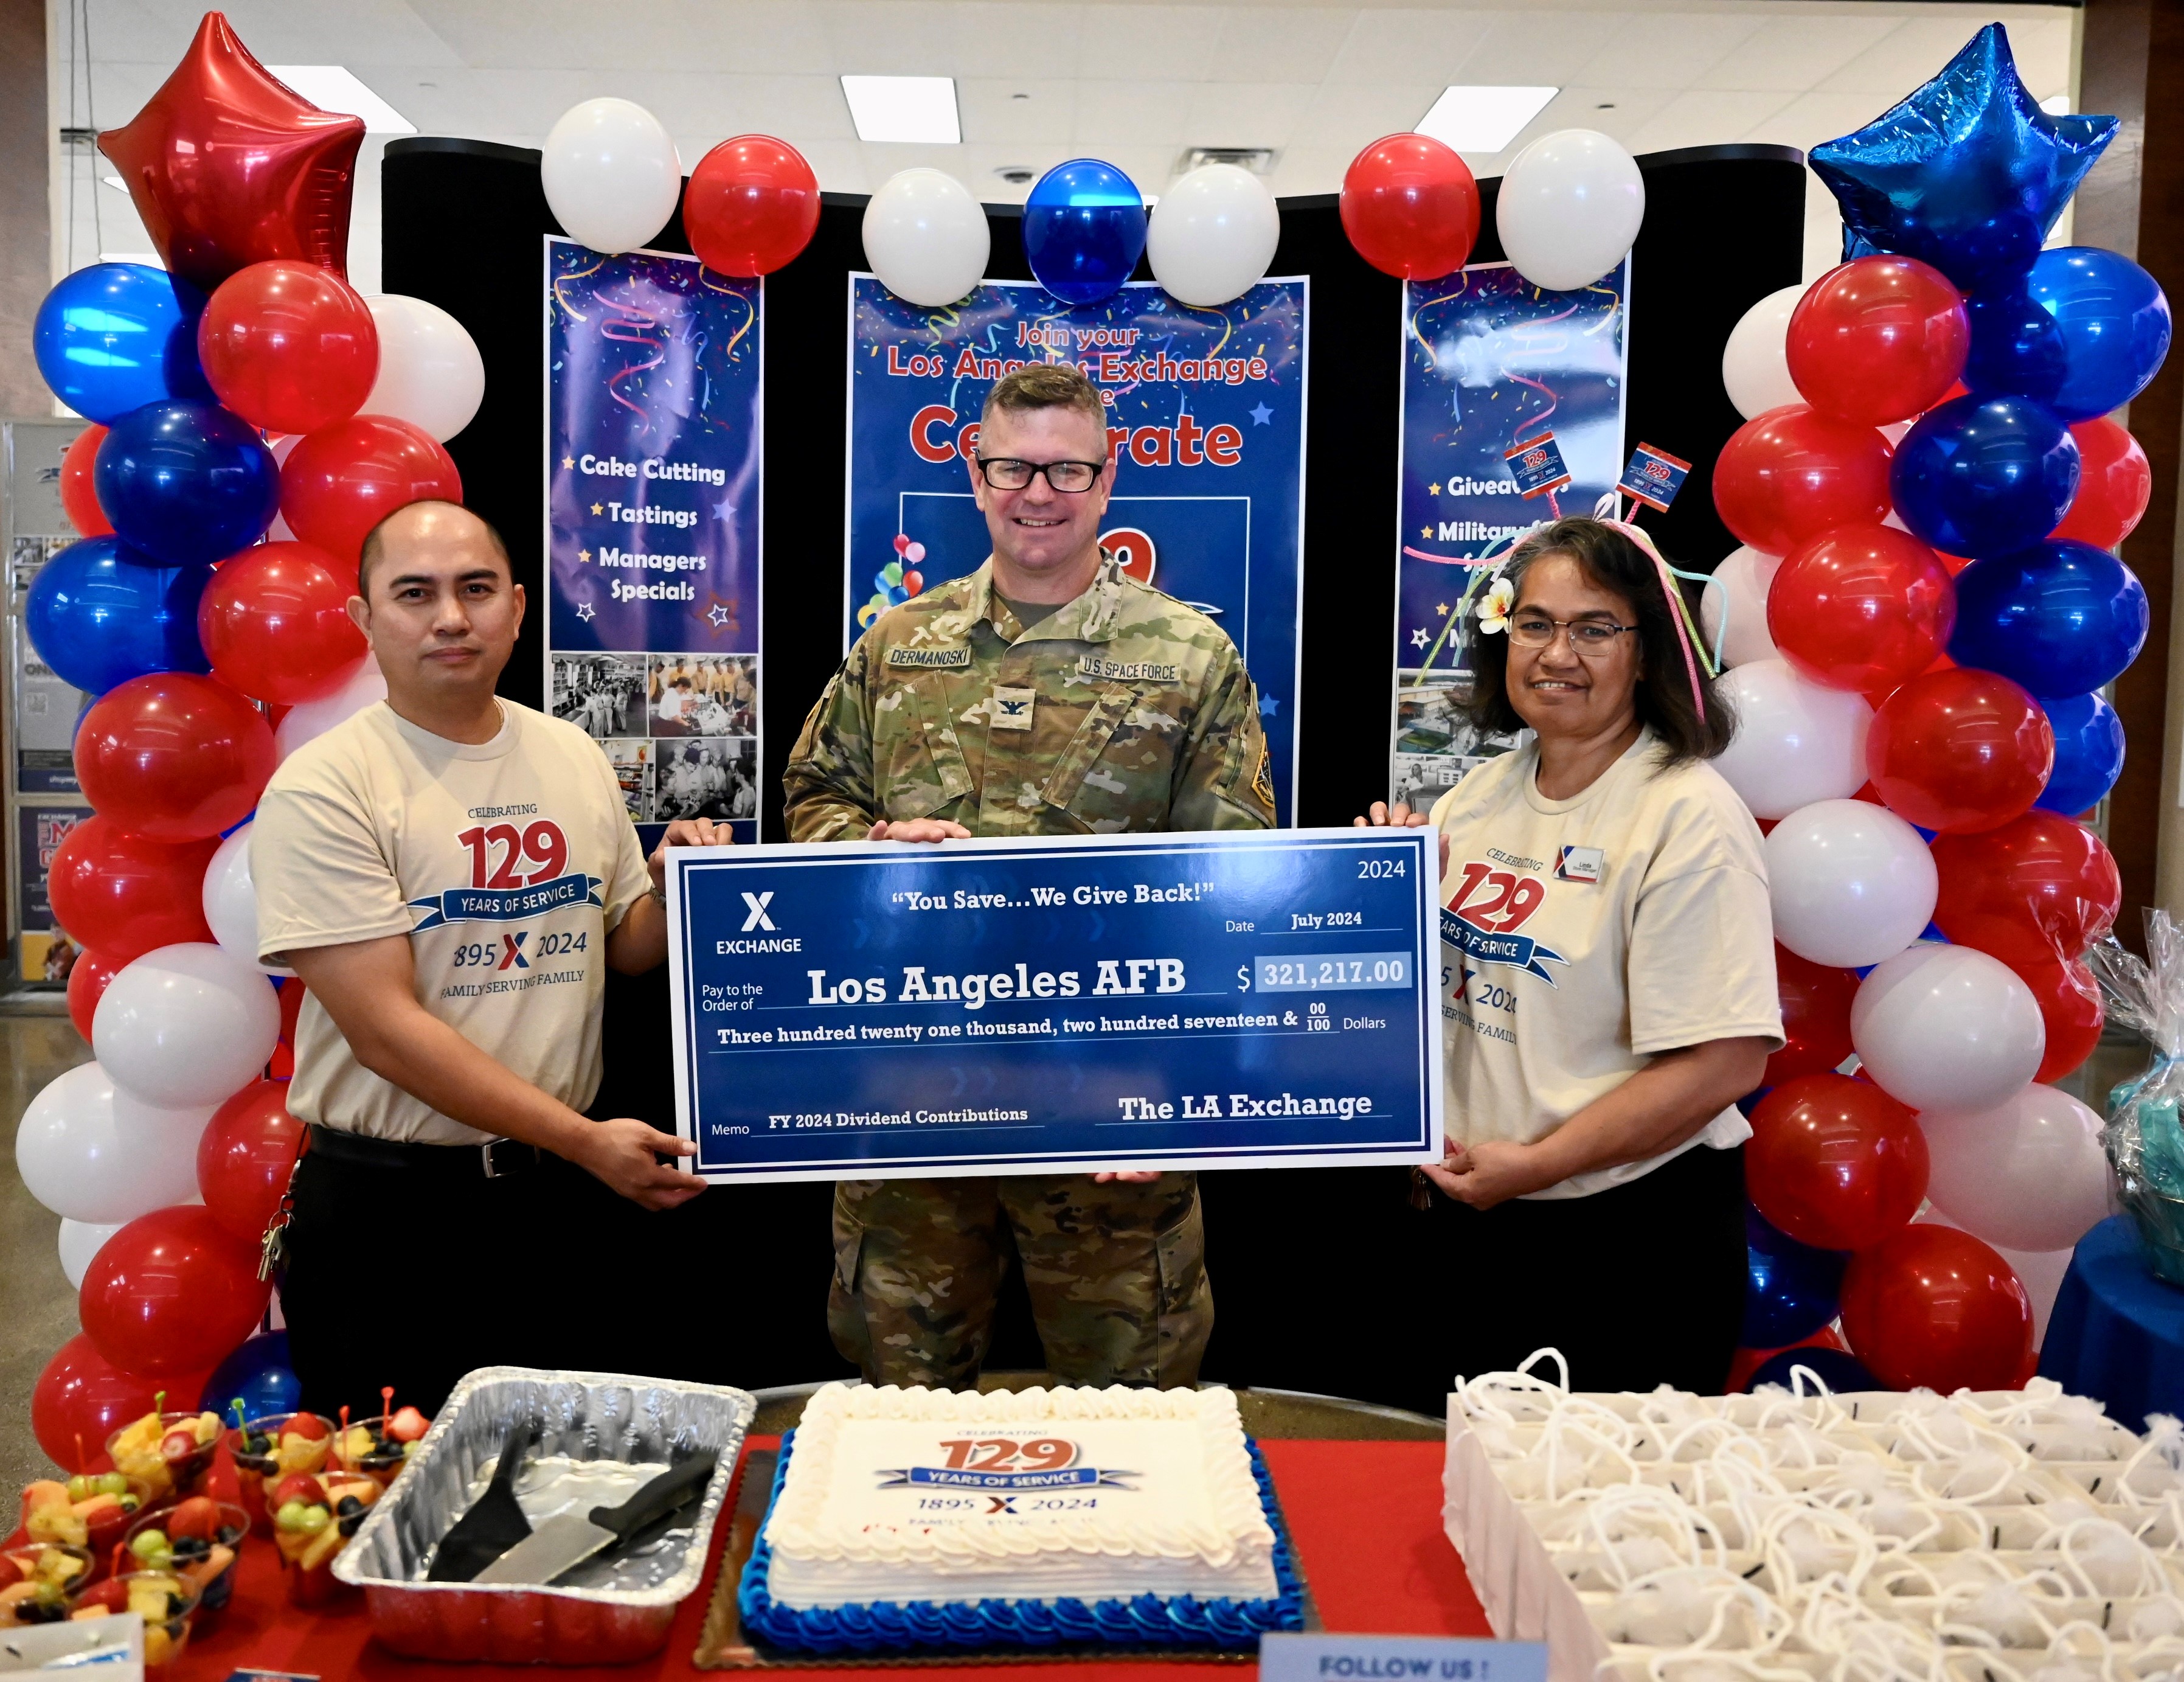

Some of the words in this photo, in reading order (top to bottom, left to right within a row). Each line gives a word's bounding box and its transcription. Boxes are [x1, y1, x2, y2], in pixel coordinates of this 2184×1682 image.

[1017, 321, 1069, 348] Join
[1077, 328, 1139, 351] your
[887, 346, 944, 378] Los
[1099, 352, 1267, 386] Exchange
[910, 405, 1243, 467] Cerate
[580, 454, 637, 478] Cake
[643, 459, 726, 486] Cutting
[1522, 450, 1547, 468] 129
[1644, 461, 1670, 481] 129
[608, 502, 698, 528] Tastings
[599, 547, 707, 572] Managers
[611, 579, 695, 602] Specials
[890, 649, 968, 665] DERMANOSKI
[1084, 657, 1101, 674] U.S.
[1105, 662, 1139, 678] SPACE
[1142, 664, 1175, 679] FORCE
[468, 804, 538, 819] CELEBRATING
[456, 819, 569, 889] 129
[1486, 847, 1544, 872] CELEBRATING
[1357, 860, 1406, 879] 2024
[461, 897, 499, 912] YEARS
[505, 897, 519, 912] OF
[523, 884, 575, 909] SERVICE
[1073, 886, 1128, 905] Give
[1446, 861, 1547, 934] 129
[1225, 920, 1255, 933] Date
[1291, 913, 1323, 931] July
[1327, 912, 1362, 926] 2024
[536, 931, 587, 957] 2024
[716, 939, 802, 954] EXCHANGE
[1463, 931, 1481, 948] OF
[440, 984, 486, 999] FAMILY
[486, 976, 536, 993] SERVING
[537, 970, 584, 985] FAMILY
[702, 999, 738, 1012] Order
[741, 998, 754, 1010] of
[807, 970, 886, 1005] Los
[899, 964, 1080, 1010] Angeles
[1092, 959, 1186, 995] AFB
[1237, 965, 1250, 992] $
[1264, 960, 1404, 988] 321,217.00
[702, 984, 724, 998] Pay
[726, 985, 740, 996] to
[742, 984, 763, 995] the
[1476, 984, 1517, 1014] 2024
[1310, 1003, 1326, 1015] 00
[717, 1029, 772, 1044] Three
[777, 1025, 856, 1043] hundred
[861, 1024, 923, 1041] twenty
[927, 1023, 961, 1037] one
[966, 1018, 1058, 1037] thousand,
[1063, 1018, 1095, 1032] two
[1100, 1014, 1179, 1031] hundred
[1184, 1013, 1278, 1029] seventeen
[1283, 1010, 1298, 1026] &
[1307, 1018, 1329, 1032] 100
[1343, 1016, 1385, 1030] Dollars
[1118, 1097, 1174, 1121] The
[1182, 1095, 1222, 1118] LA
[1229, 1094, 1372, 1121] Exchange
[712, 1124, 749, 1136] Memo
[769, 1114, 791, 1129] FY
[796, 1113, 832, 1127] 2024
[836, 1111, 911, 1126] Dividend
[915, 1108, 1028, 1123] Contributions
[939, 1438, 1075, 1472] 129
[929, 1471, 981, 1486] YEARS
[983, 1476, 1009, 1486] OF
[1012, 1471, 1080, 1487] SERVICE
[918, 1498, 975, 1510] 1895
[1030, 1498, 1097, 1510] 2024
[1319, 1655, 1432, 1677] FOLLOW
[1441, 1658, 1472, 1680] US
